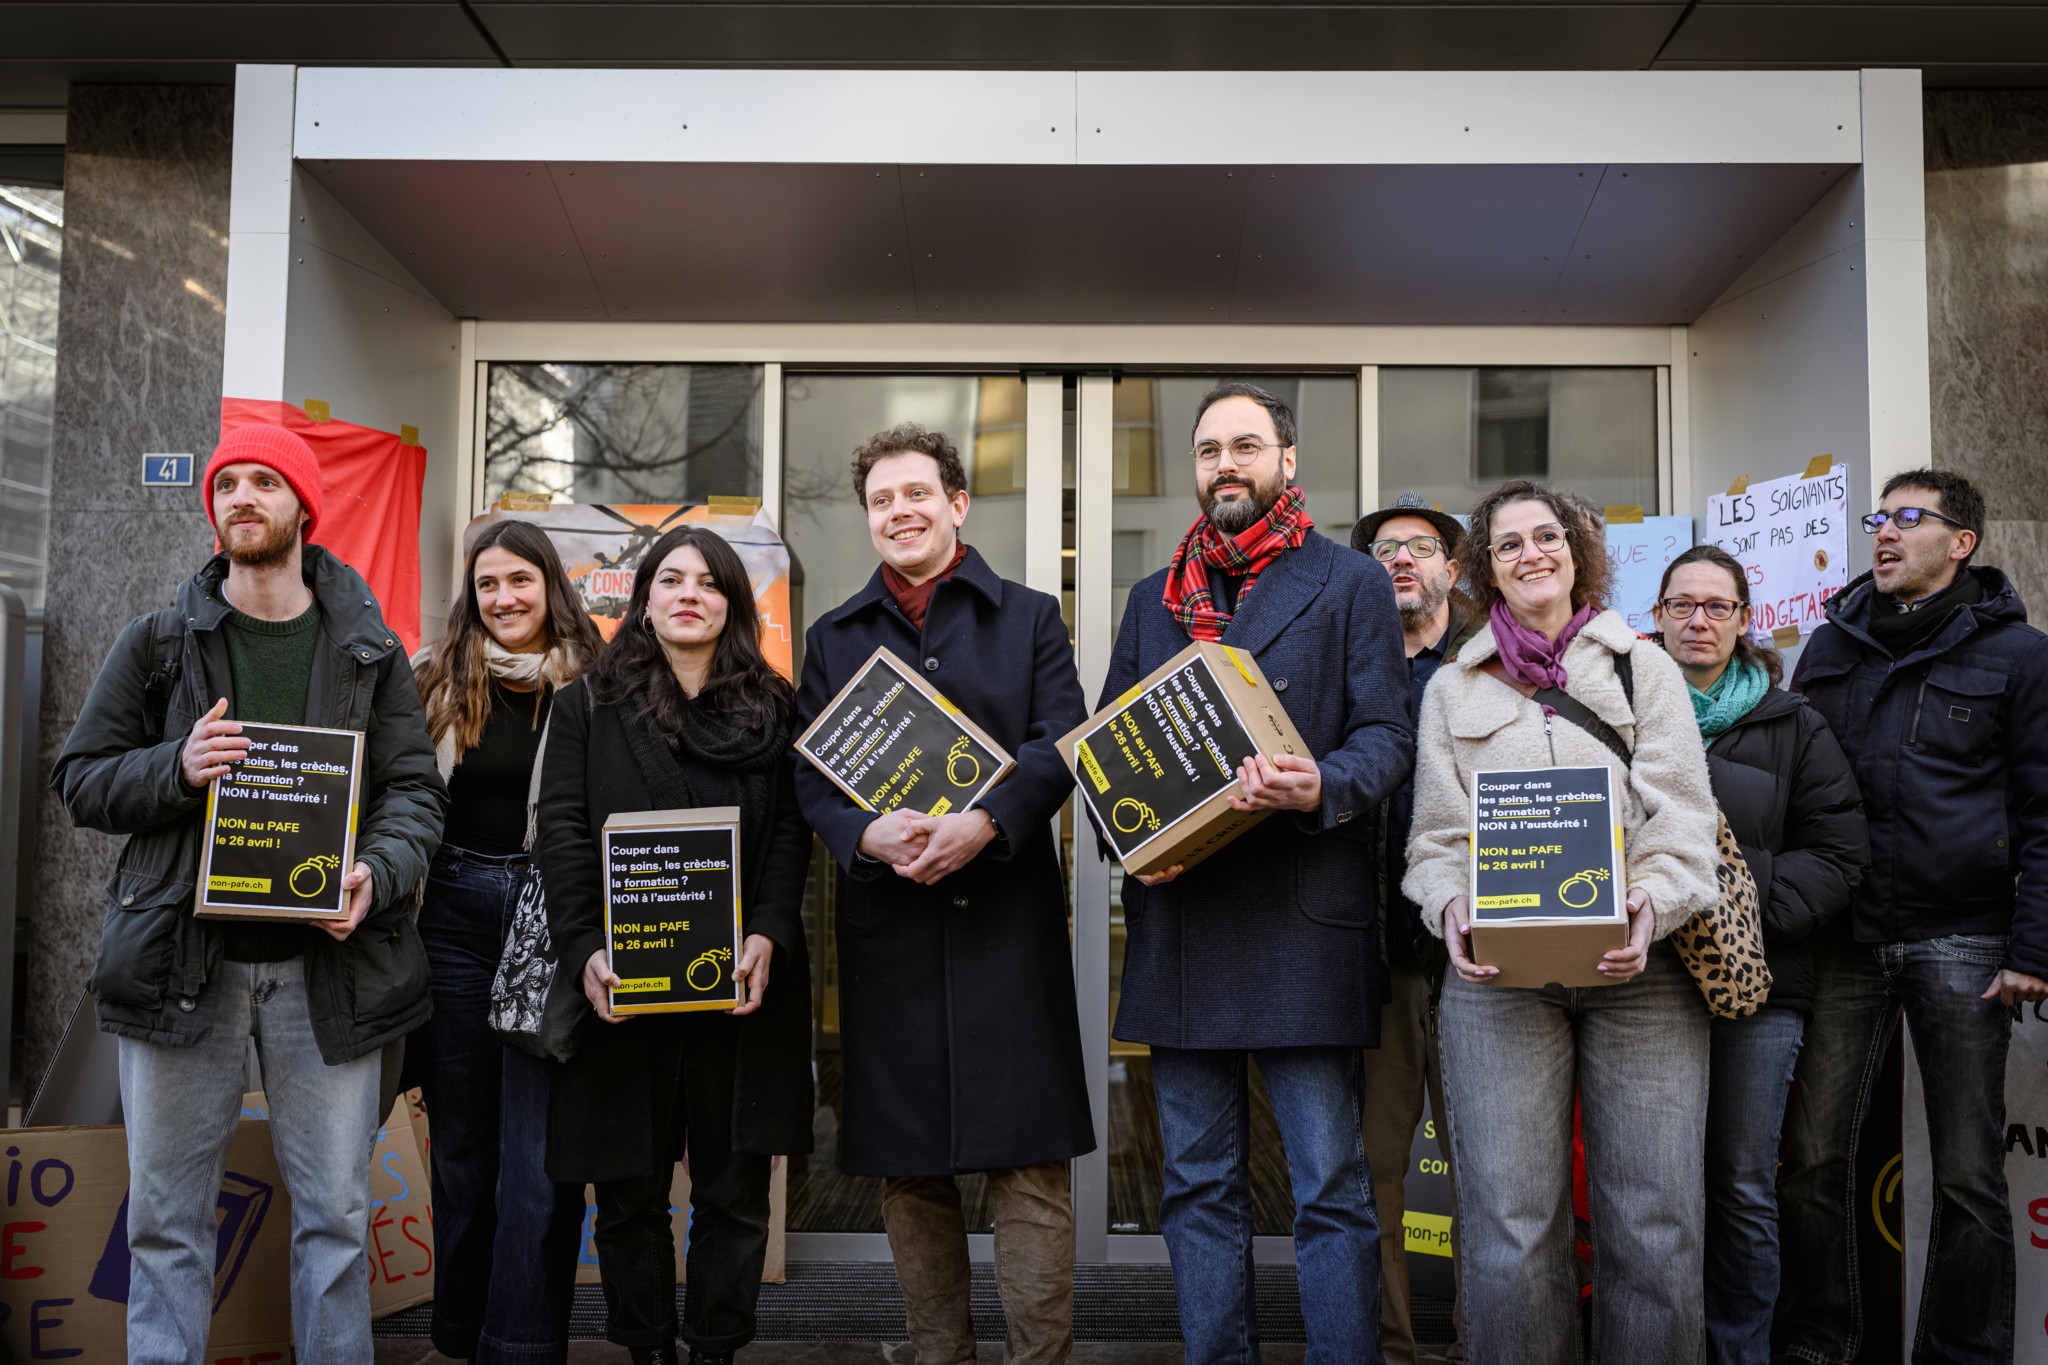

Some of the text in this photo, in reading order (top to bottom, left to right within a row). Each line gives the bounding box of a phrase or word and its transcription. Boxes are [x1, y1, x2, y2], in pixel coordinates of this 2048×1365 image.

[158, 458, 178, 480] 41
[1720, 496, 1755, 526] LES
[1730, 531, 1760, 557] SONT
[1771, 526, 1794, 547] PAS
[1804, 518, 1830, 538] DES
[1664, 536, 1676, 562] ?
[592, 572, 633, 594] CONS
[1744, 564, 1764, 586] ES
[1184, 666, 1222, 728] Couper dans
[1144, 694, 1162, 720] NON
[1158, 716, 1167, 727] à
[1157, 684, 1201, 752] la formation ?
[815, 704, 862, 757] Couper dans
[826, 682, 904, 768] les soins, les crèches,
[1170, 674, 1232, 780] les soins, les crèches,
[271, 742, 298, 752] dans
[837, 718, 889, 778] la formation ?
[848, 764, 870, 788] NON
[868, 758, 876, 766] à
[908, 710, 916, 718] !
[1108, 720, 1144, 774] le 26 avril !
[1121, 710, 1165, 779] NON au PAFE
[244, 757, 278, 769] soins,
[281, 758, 298, 769] les
[301, 761, 348, 774] crèches,
[1078, 744, 1104, 786] non-pafe.ch
[222, 772, 304, 786] la formation ?
[869, 746, 923, 806] NON au PAFE
[220, 786, 249, 798] NON
[252, 789, 259, 799] à
[323, 794, 328, 804] !
[880, 768, 924, 814] le 26 avril !
[1479, 782, 1552, 792] Couper dans
[1480, 792, 1606, 804] les soins, les crèches,
[1480, 806, 1561, 817] la formation ?
[218, 818, 300, 832] NON au PAFE
[1479, 822, 1508, 831] NON
[1510, 821, 1518, 830] à
[1583, 819, 1588, 827] !
[215, 834, 280, 848] le 26 avril !
[611, 844, 680, 857] Couper dans
[1479, 845, 1562, 856] NON au PAFE
[612, 858, 730, 872] les soins, les crèches,
[1479, 860, 1545, 870] le 26 avril !
[210, 880, 264, 889] non-pafe.ch
[612, 876, 688, 888] la formation ?
[612, 893, 638, 904] NON
[641, 892, 648, 902] à
[708, 890, 712, 900] !
[1478, 897, 1532, 906] non-pafe.ch
[614, 920, 690, 934] NON au PAFE
[614, 938, 674, 950] le 26 avril !
